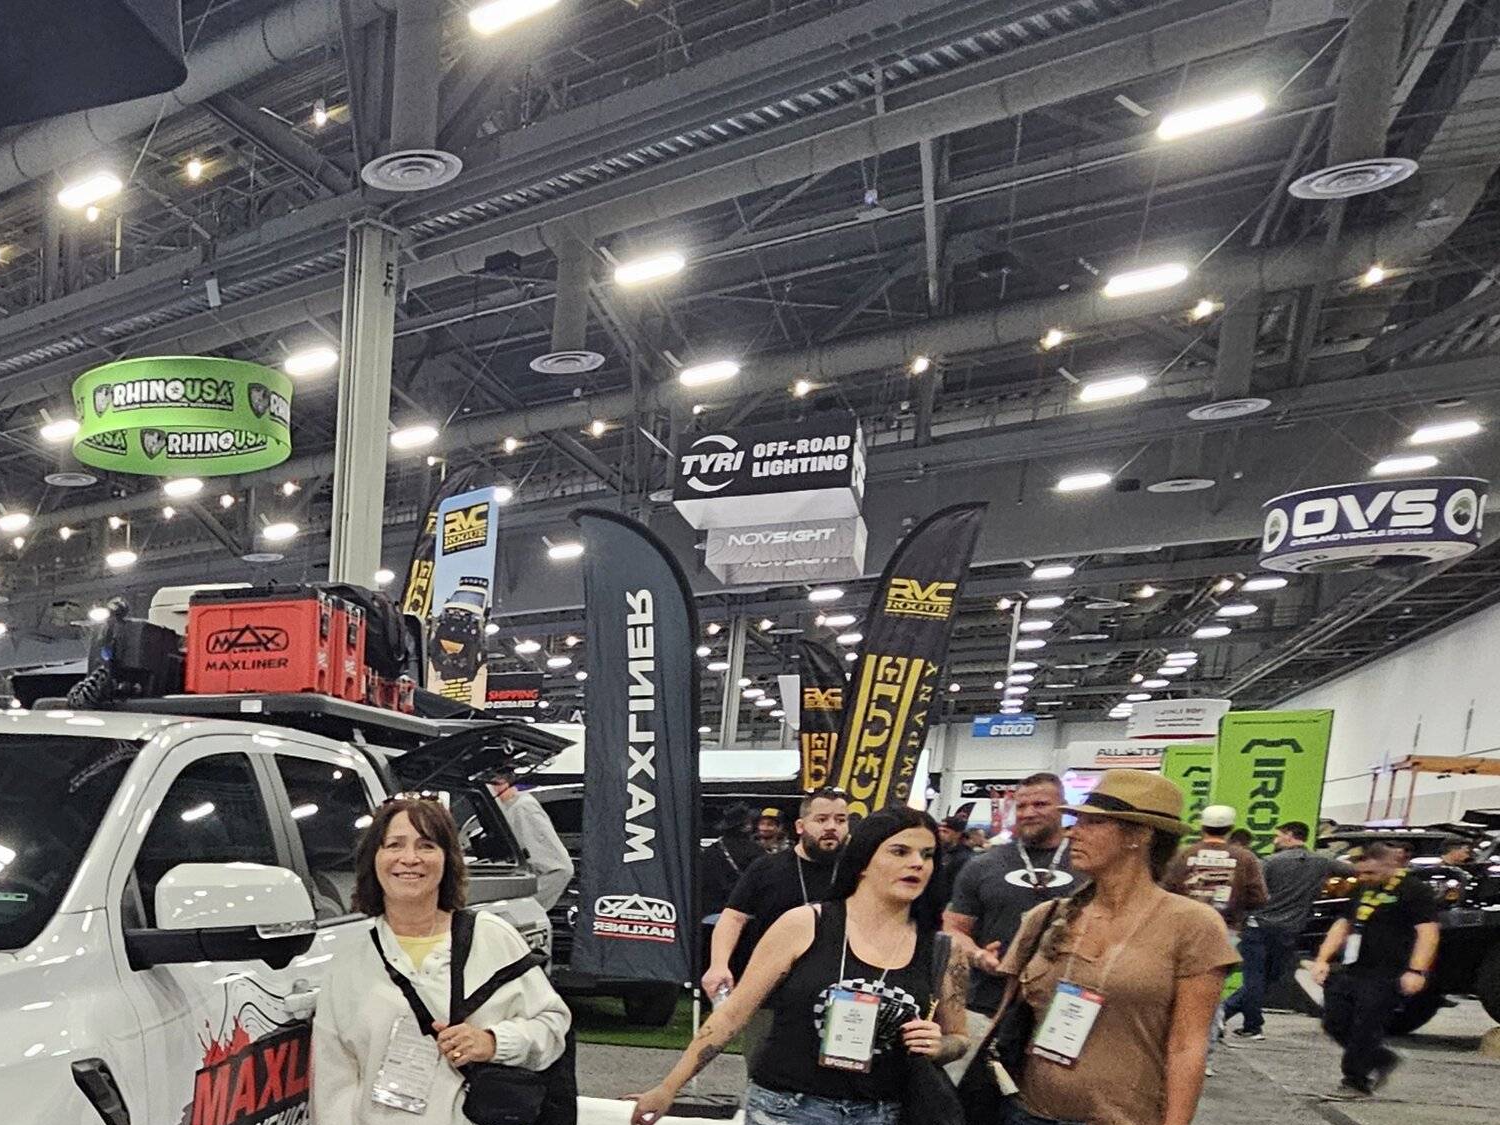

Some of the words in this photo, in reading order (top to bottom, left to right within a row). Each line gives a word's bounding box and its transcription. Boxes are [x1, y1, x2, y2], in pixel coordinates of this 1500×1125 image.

[752, 435, 850, 458] OFF-ROAD
[681, 450, 745, 476] TYRI
[752, 454, 848, 478] LIGHTING
[1292, 489, 1439, 537] OVS
[728, 528, 836, 546] NOVSIGHT
[1342, 529, 1386, 541] VEHICLE
[1387, 527, 1434, 537] SYSTEMS
[205, 658, 289, 672] MAXLINER
[989, 722, 1034, 736] 61000
